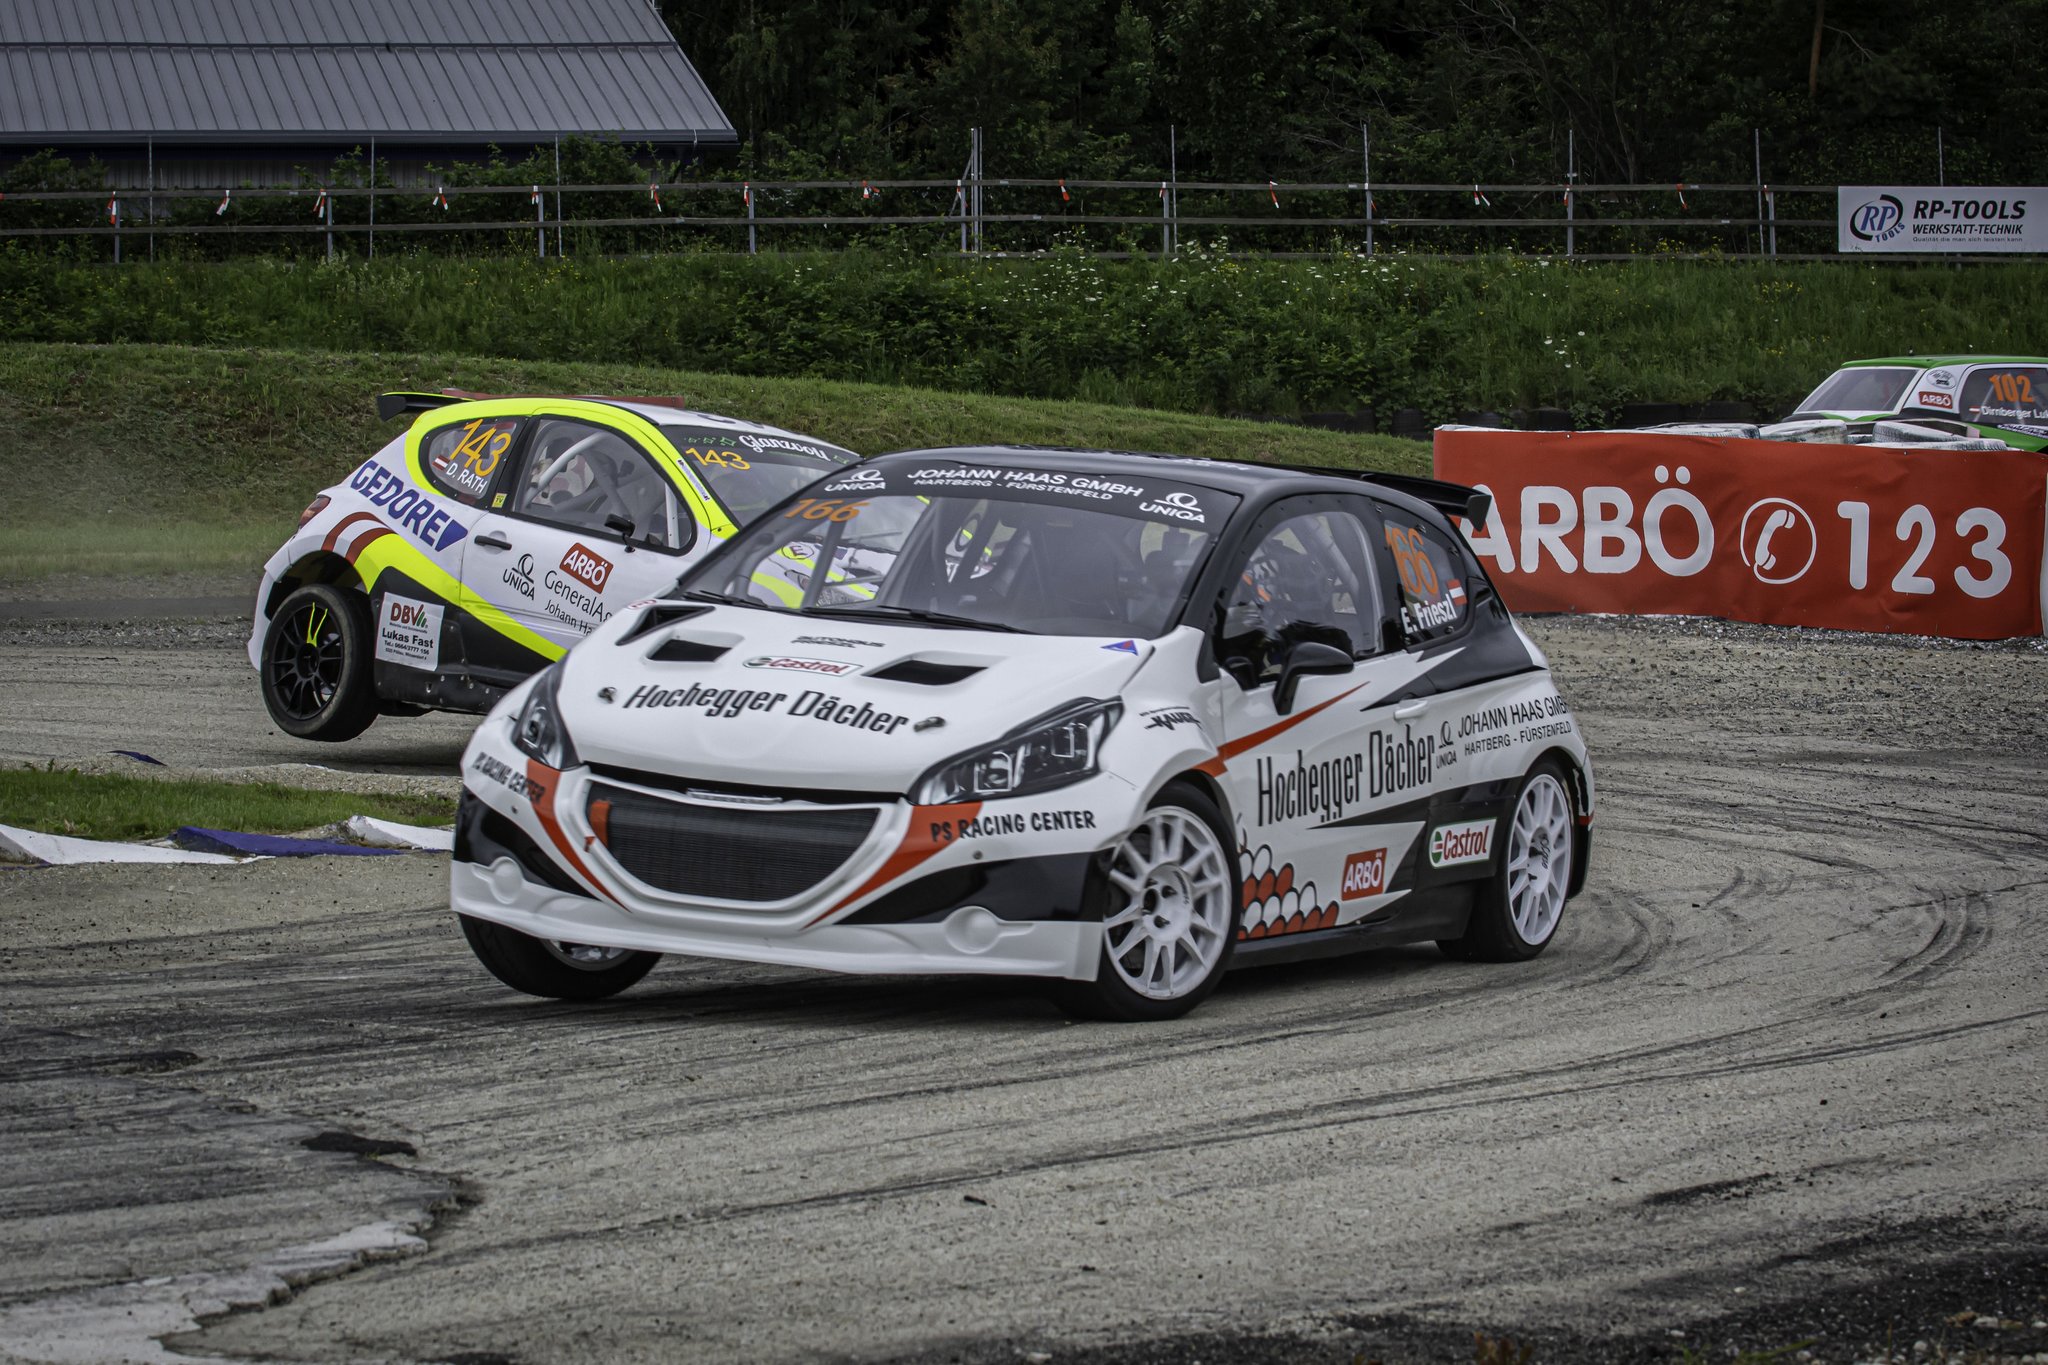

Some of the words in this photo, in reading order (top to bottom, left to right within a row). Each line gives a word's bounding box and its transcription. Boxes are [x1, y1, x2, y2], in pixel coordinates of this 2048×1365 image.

[1860, 206, 1896, 231] RP
[1913, 200, 2027, 219] RP-TOOLS
[1875, 222, 1905, 243] TOOLS
[1912, 224, 2023, 235] WERKSTATT-TECHNIK
[1921, 393, 1951, 406] ARBÖ
[1988, 374, 2034, 403] 102
[1981, 406, 2031, 419] Dirnberger
[450, 419, 511, 477] 143
[686, 447, 751, 471] 143
[446, 462, 458, 478] D.
[458, 469, 487, 493] RATH
[824, 482, 886, 492] UNIQA
[907, 469, 1001, 480] JOHANN
[1003, 471, 1067, 485] HAAS
[1071, 478, 1144, 497] GMBH
[914, 479, 993, 487] HARTBERG
[1006, 481, 1113, 501] FÜRSTENFELD
[350, 460, 451, 547] GEDORE
[784, 498, 870, 522] 166
[1139, 502, 1206, 523] UNIQA
[1460, 465, 1714, 576] ARBÖ
[563, 550, 608, 586] ARBÖ
[503, 568, 535, 601] UNIQA
[390, 602, 424, 626] DBV
[545, 600, 576, 628] Johann
[1401, 607, 1417, 634] E.
[1414, 593, 1457, 629] Frieszl
[382, 628, 409, 643] Lukas
[412, 635, 433, 648] Fast
[768, 658, 851, 673] Castrol
[622, 682, 787, 718] Hochegger
[787, 690, 910, 735] Dächer
[1458, 706, 1508, 738] JOHANN
[1510, 699, 1544, 725] HAAS
[1465, 734, 1511, 756] HARTBERG
[1520, 721, 1572, 743] FÜRSTENFELD
[1436, 751, 1457, 769] UNIQA
[1257, 749, 1363, 827] Hochegger
[1370, 724, 1434, 798] Dächer
[930, 822, 952, 842] PS
[957, 814, 1026, 839] RACING
[1030, 810, 1097, 832] CENTER
[1443, 826, 1489, 860] Castrol
[1343, 851, 1382, 893] ARBÖ
